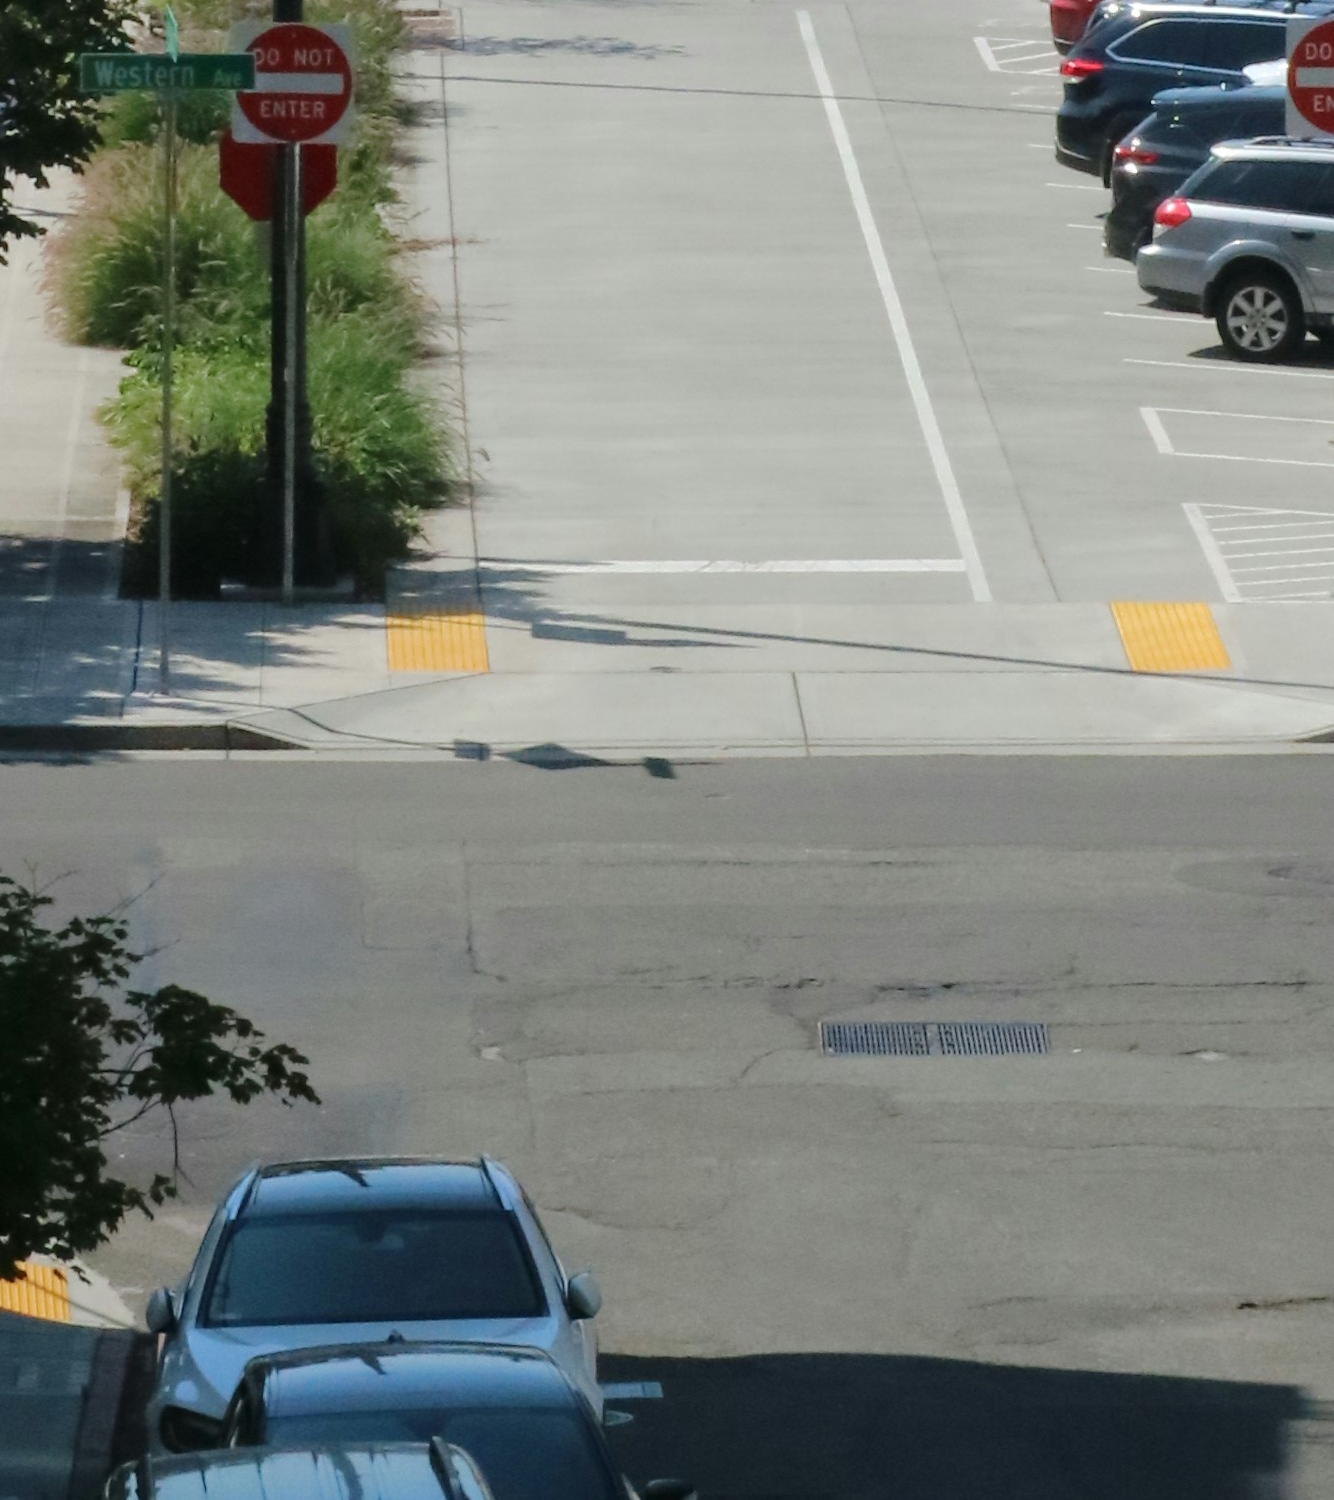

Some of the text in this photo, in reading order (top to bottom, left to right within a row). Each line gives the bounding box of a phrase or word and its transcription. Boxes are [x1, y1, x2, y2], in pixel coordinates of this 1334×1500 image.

[253, 47, 335, 67] DO NOT
[1304, 42, 1333, 61] DO
[94, 60, 243, 88] Western Ave
[259, 100, 326, 119] ENTER
